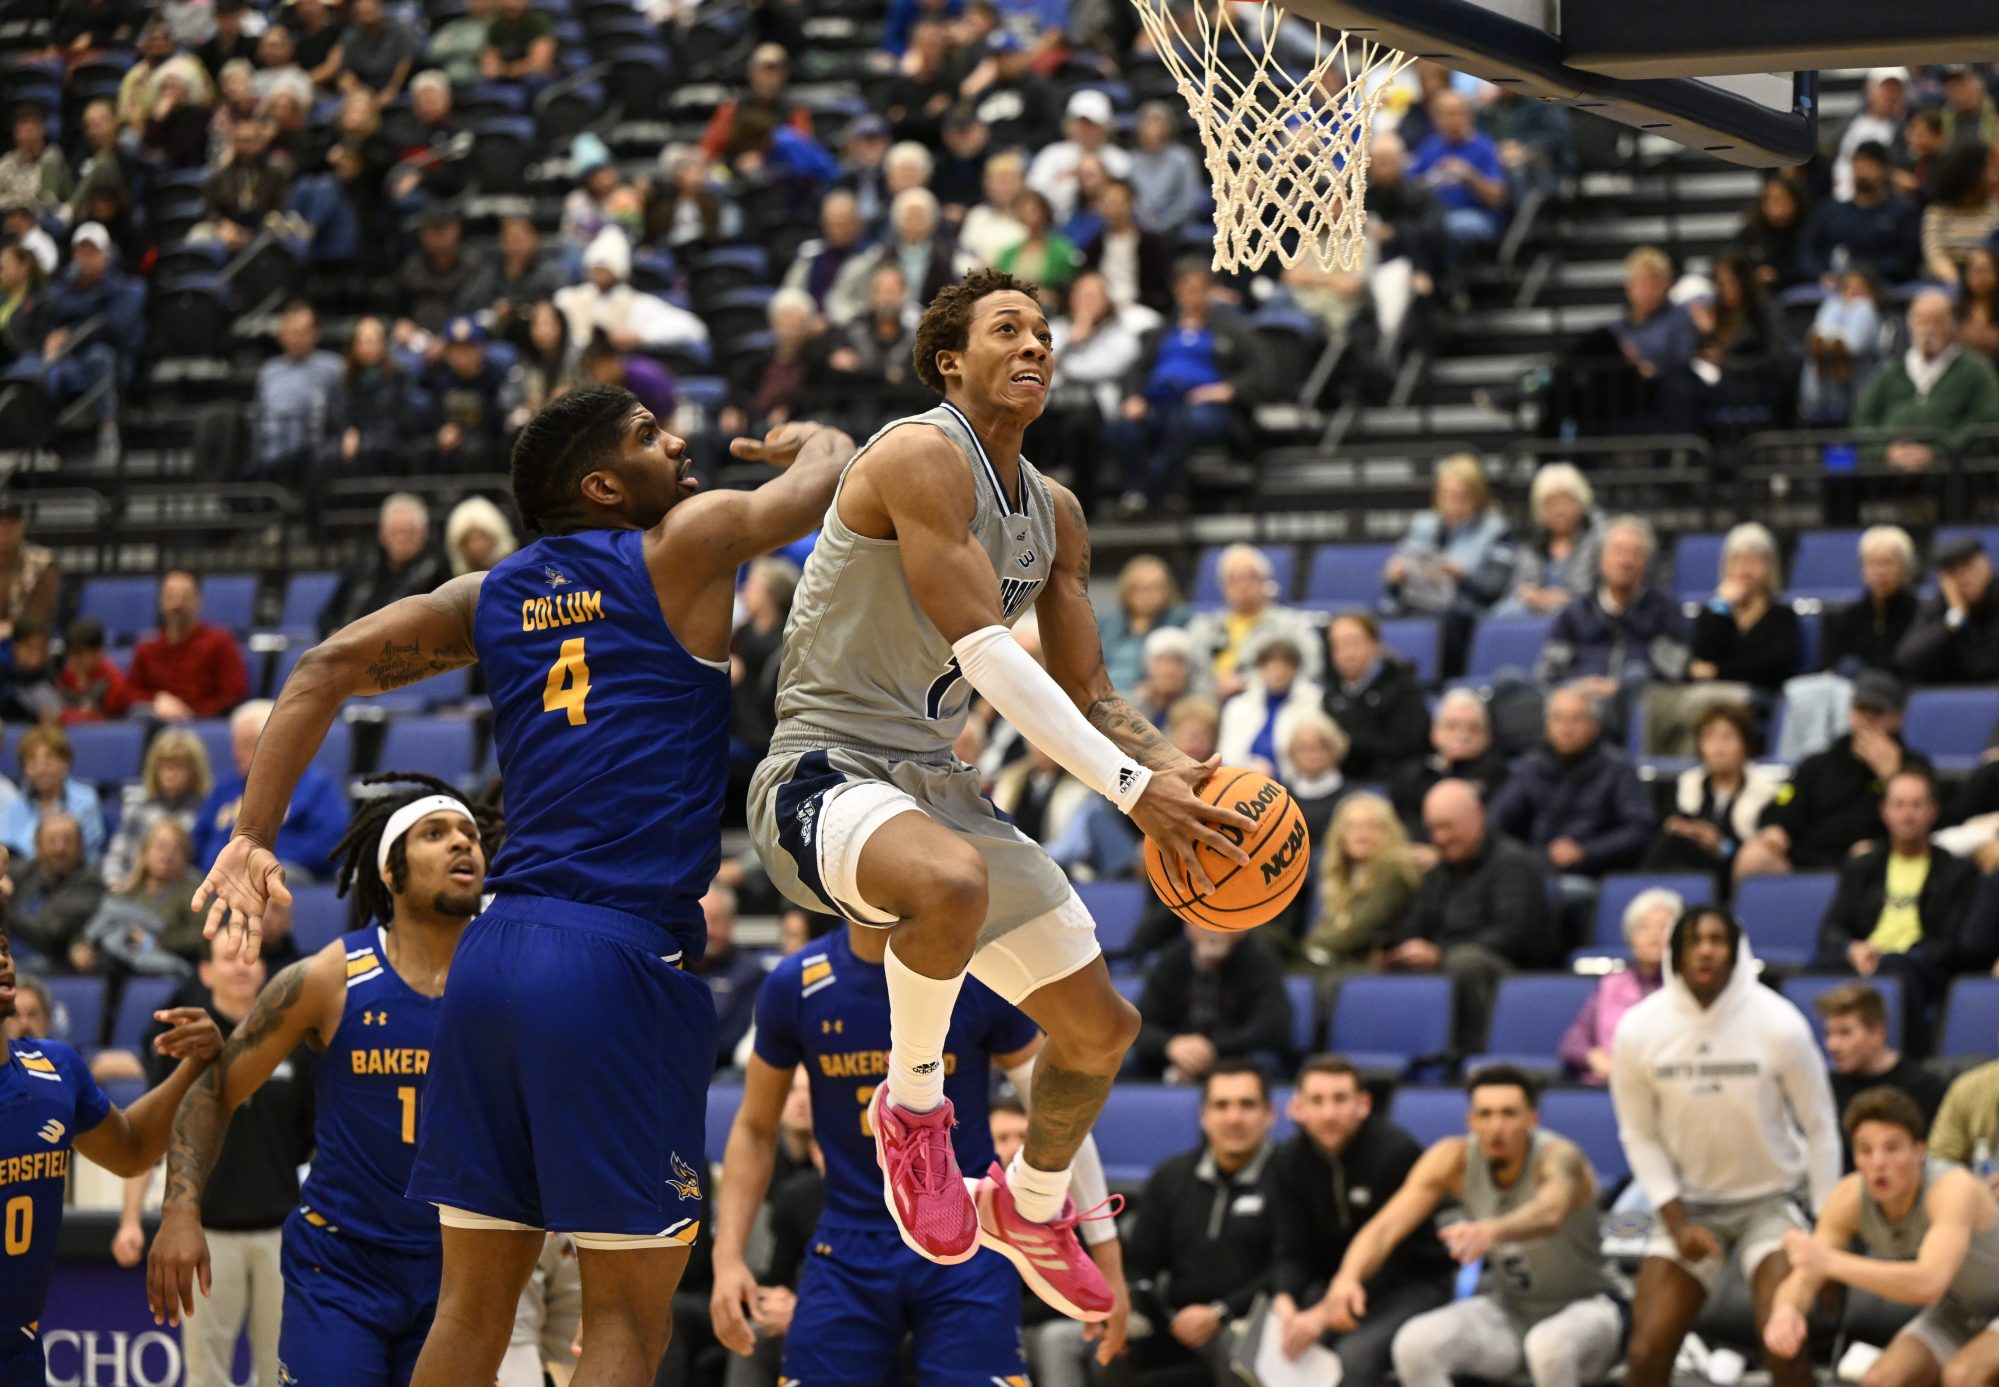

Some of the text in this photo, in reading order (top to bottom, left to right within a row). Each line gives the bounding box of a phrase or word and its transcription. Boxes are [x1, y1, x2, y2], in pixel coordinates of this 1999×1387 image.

[522, 590, 605, 632] COLLUM
[543, 637, 592, 726] 4
[1260, 818, 1305, 885] NCAA
[0, 1150, 70, 1186] ERSFIEL
[5, 1195, 33, 1256] 0
[43, 1328, 182, 1387] CHO
